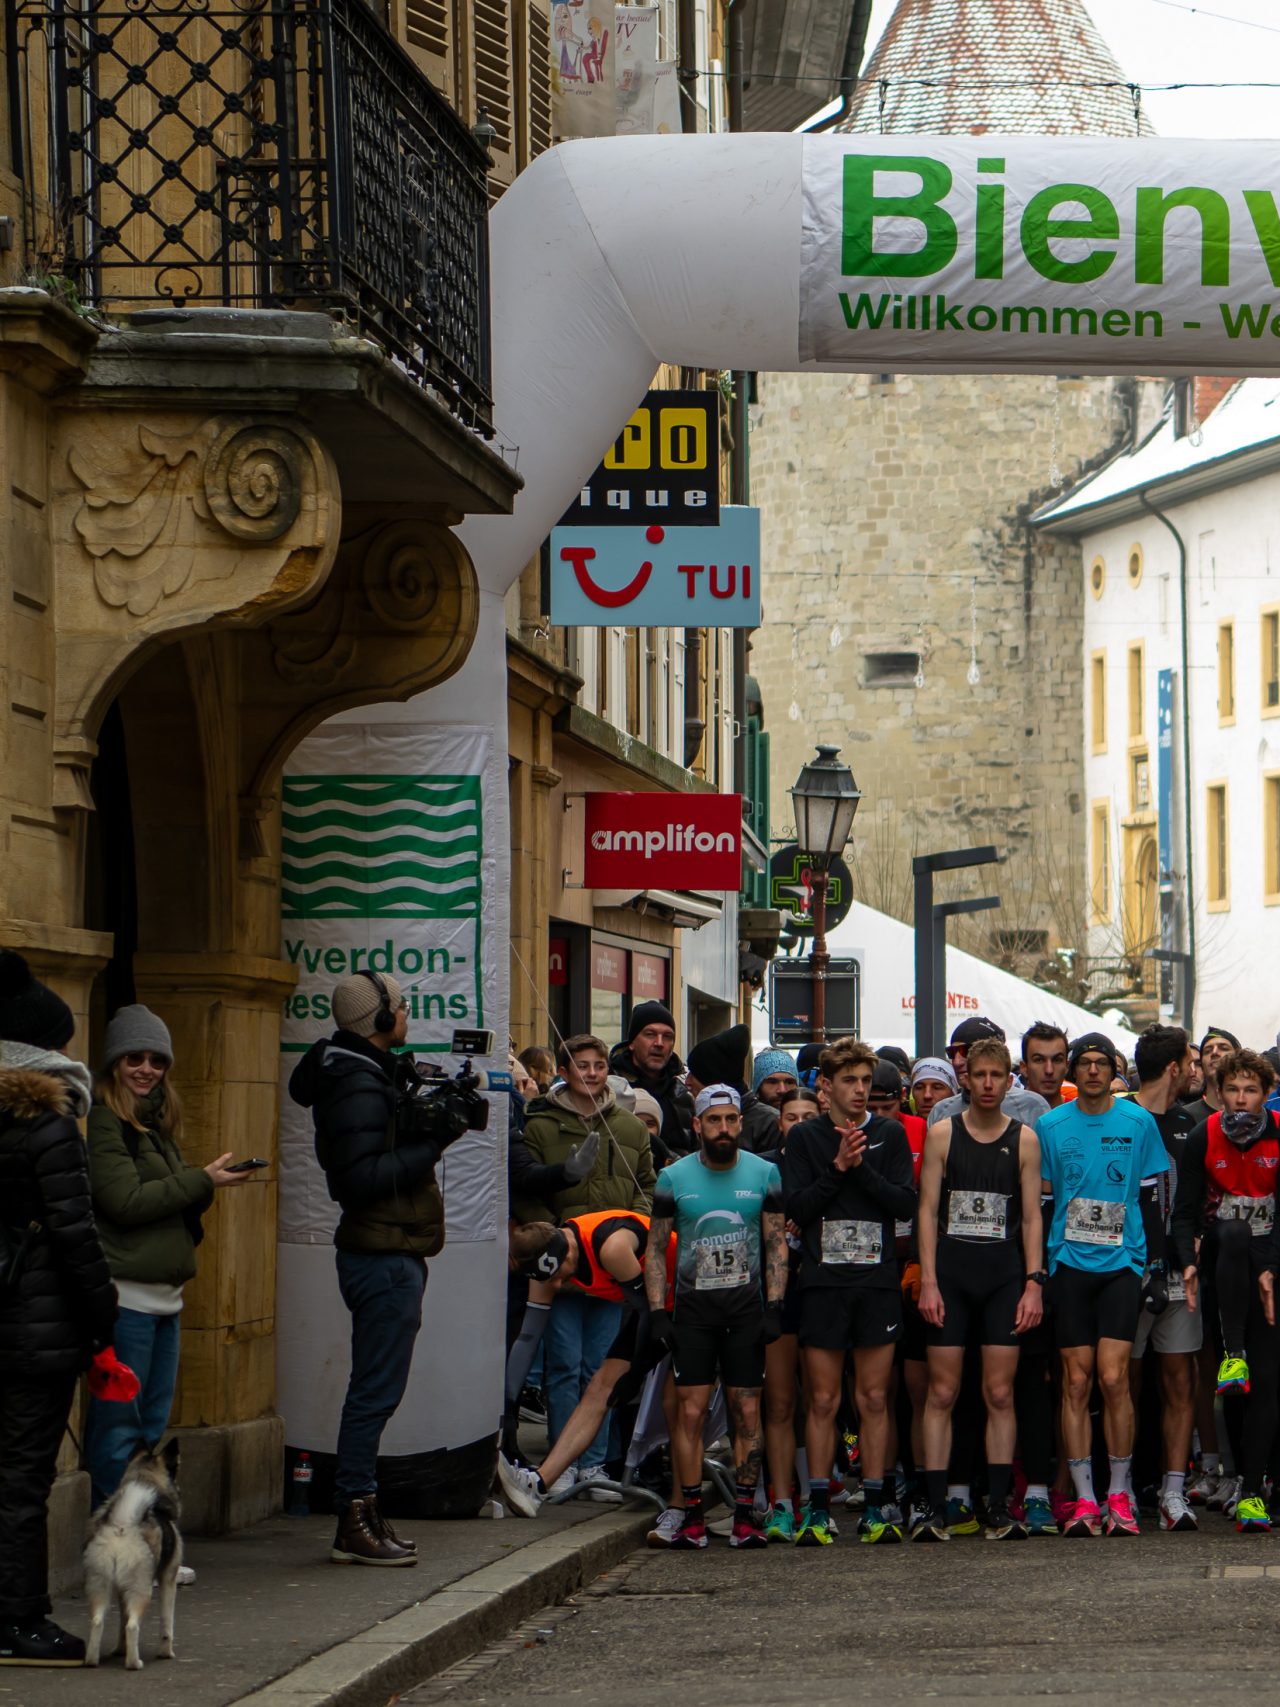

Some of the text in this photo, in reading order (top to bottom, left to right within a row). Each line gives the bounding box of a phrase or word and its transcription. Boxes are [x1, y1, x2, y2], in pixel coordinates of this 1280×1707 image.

[838, 292, 1163, 337] Willkommen
[1183, 321, 1201, 329] -
[678, 565, 751, 599] TUI
[591, 823, 735, 859] amplifon
[284, 939, 466, 974] Yverdon-
[972, 1197, 985, 1213] 8
[1091, 1205, 1102, 1221] 3
[1232, 1204, 1268, 1221] 174
[959, 1213, 997, 1224] Benjamin
[845, 1225, 858, 1242] 2
[711, 1249, 735, 1268] 15
